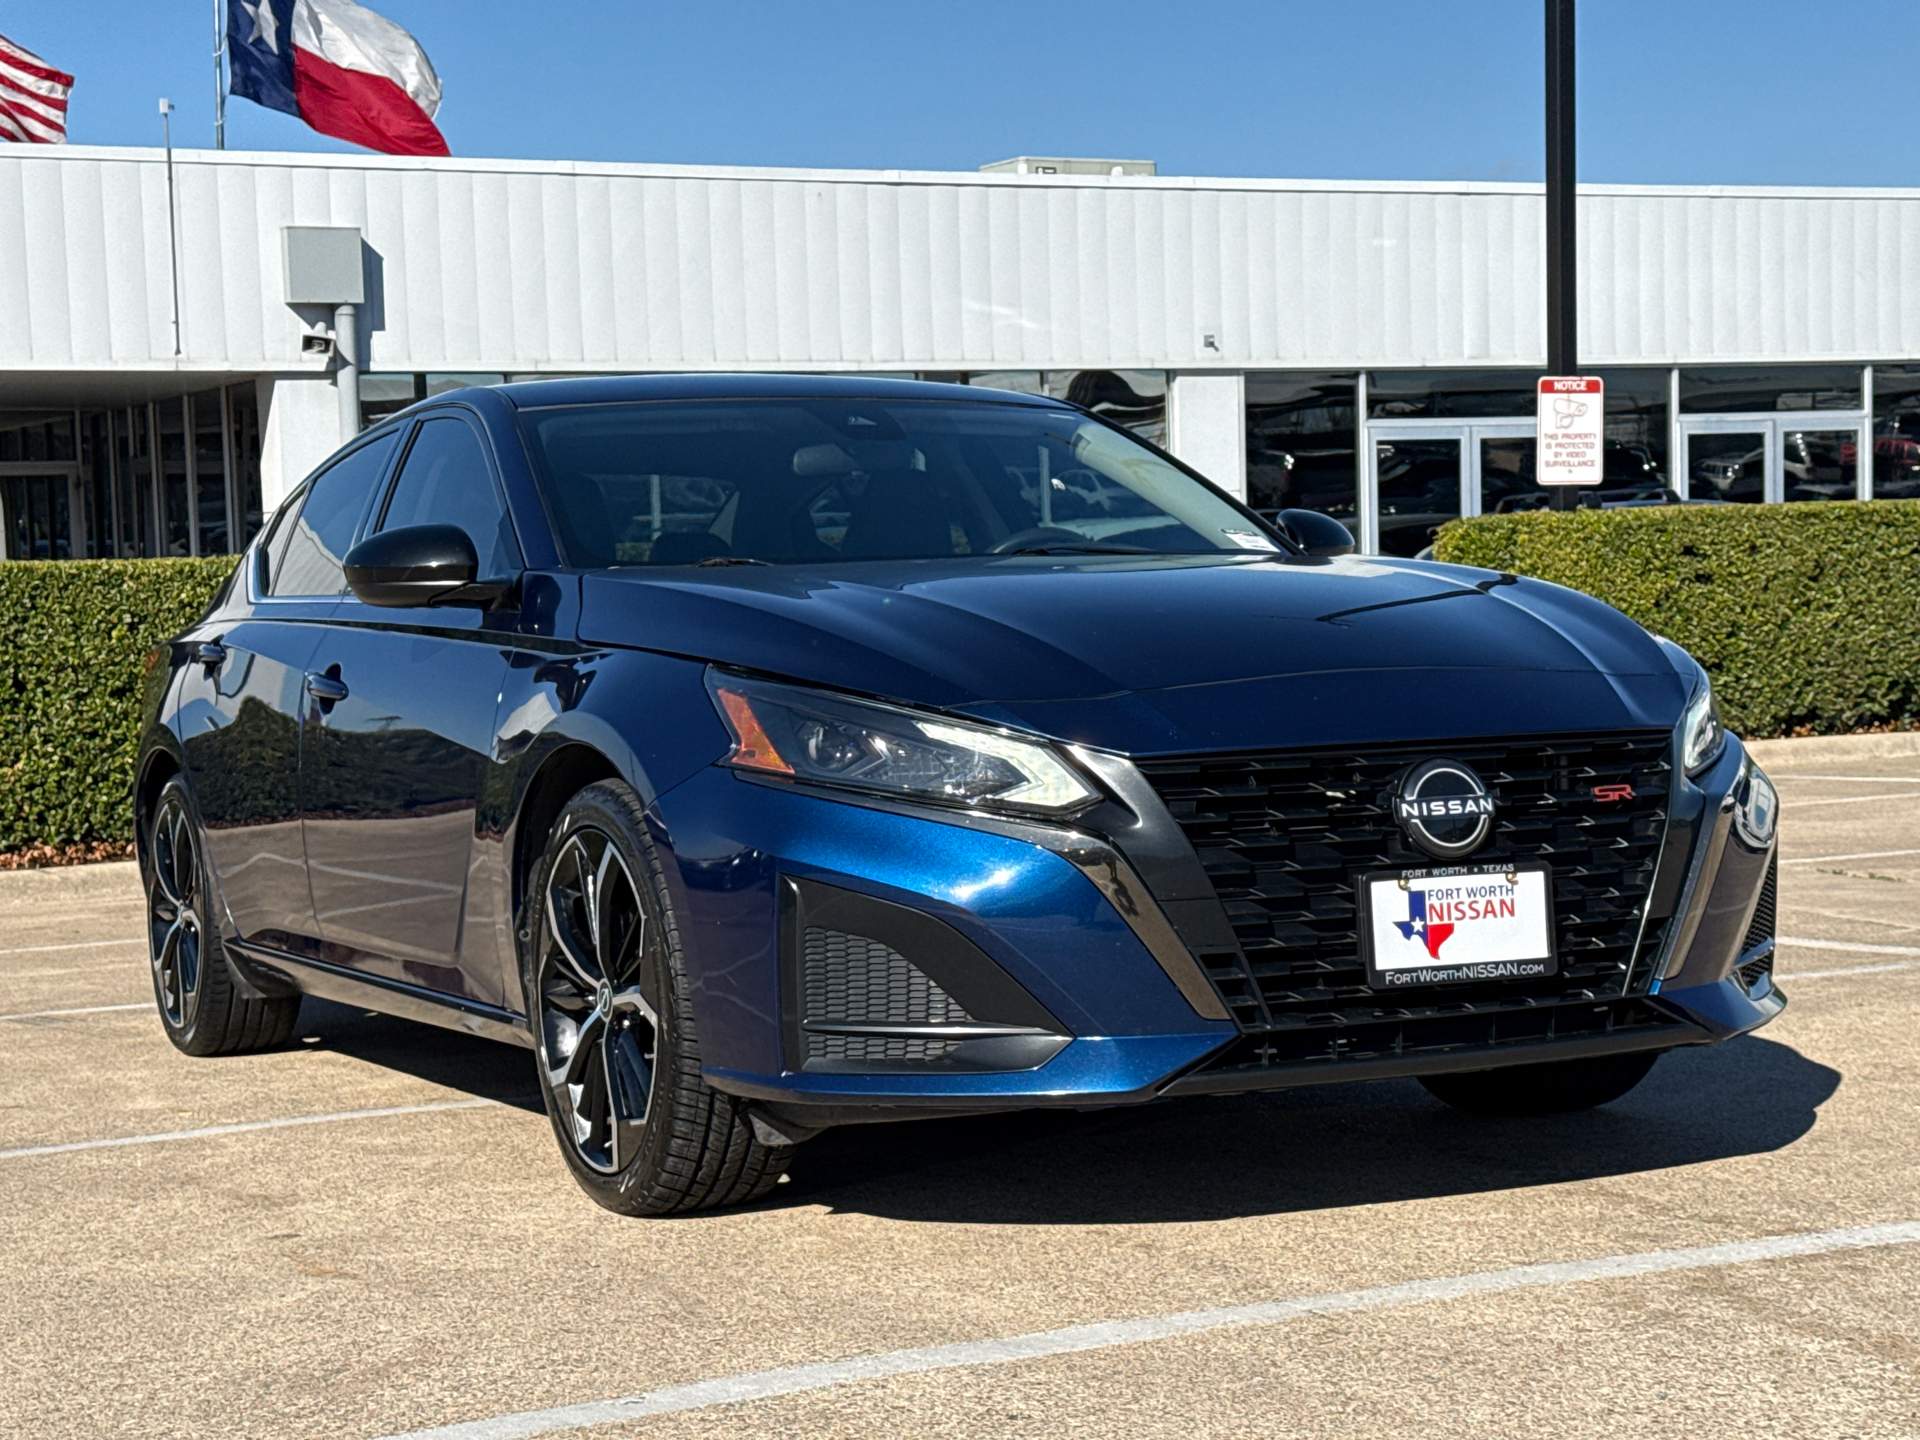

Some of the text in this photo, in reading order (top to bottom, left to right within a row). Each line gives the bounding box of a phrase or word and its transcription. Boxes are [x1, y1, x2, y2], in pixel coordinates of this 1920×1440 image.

[1554, 381, 1587, 391] NOTICE
[1592, 784, 1636, 802] SR
[1401, 798, 1493, 817] NISSAN
[1402, 863, 1515, 879] FORT WORTH TEXAS
[1427, 884, 1515, 902] FORT WORTH
[1428, 899, 1515, 922] NISSAN
